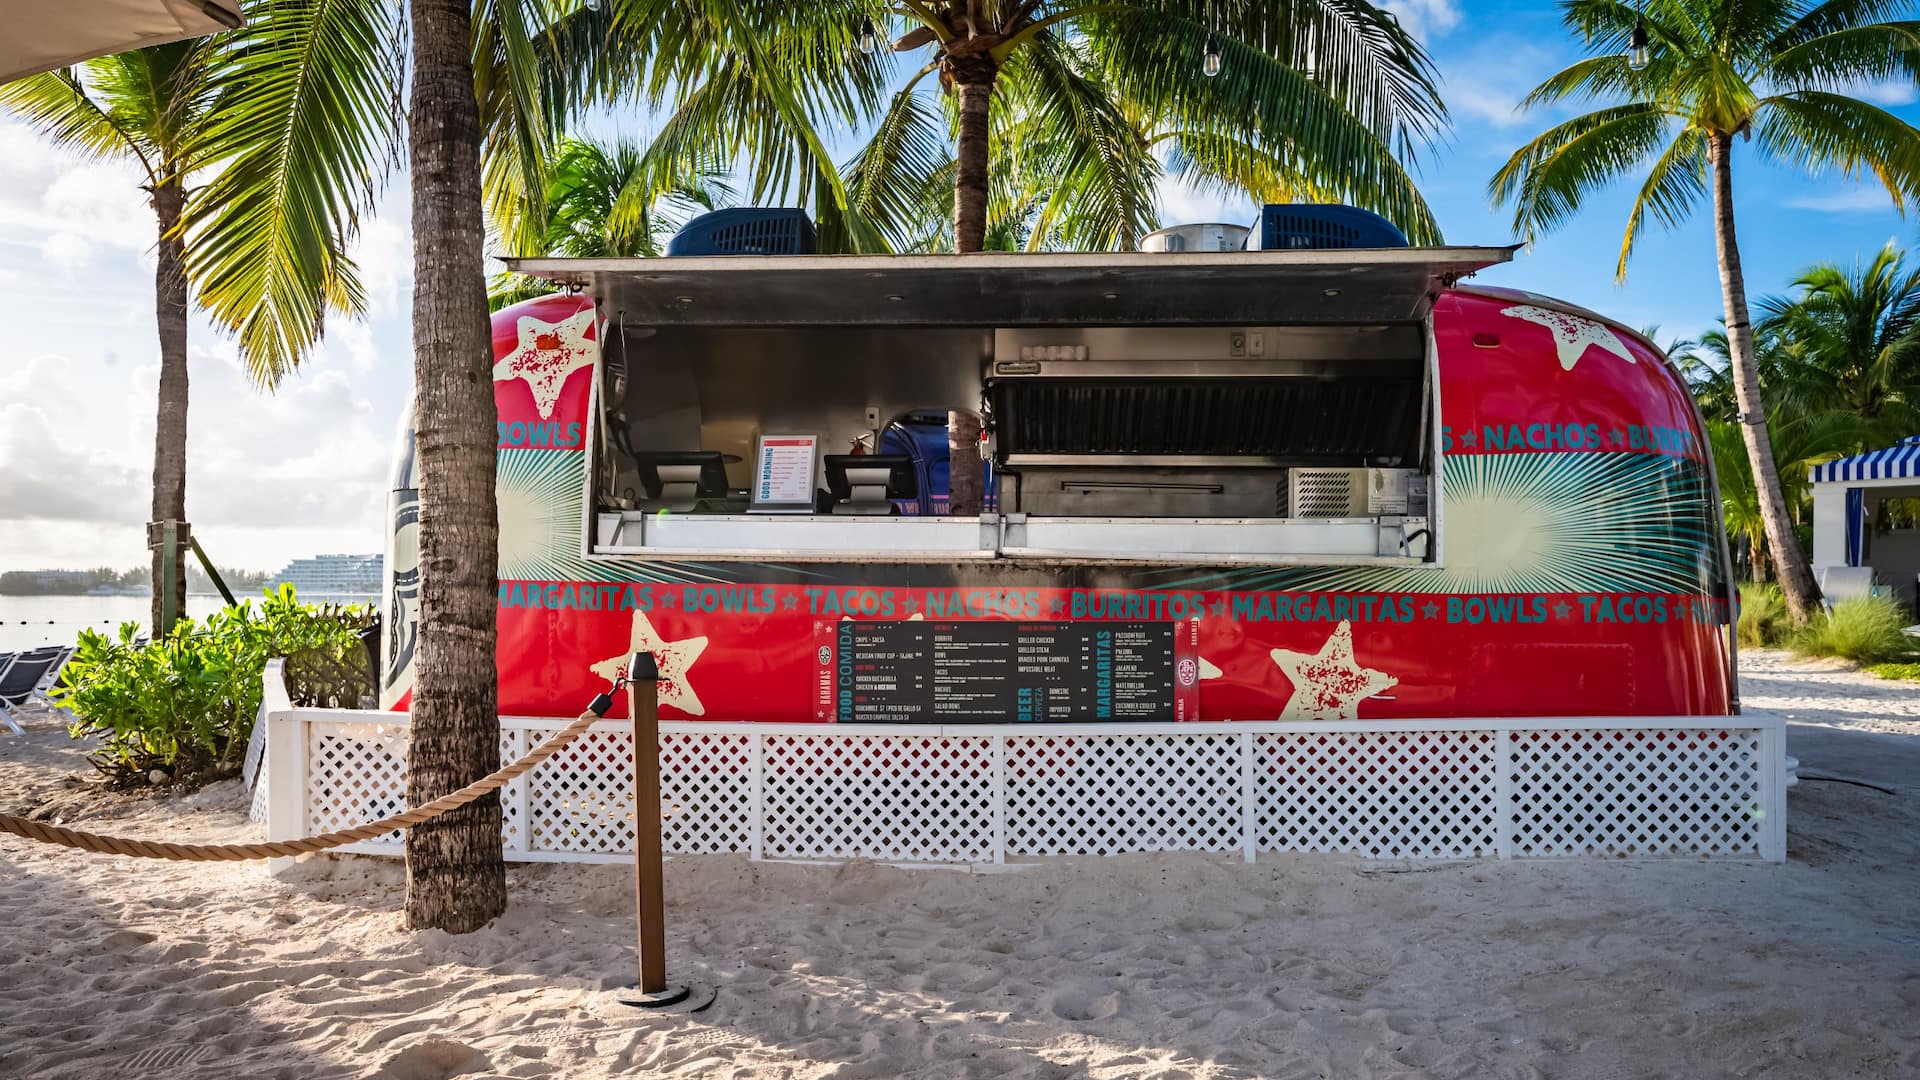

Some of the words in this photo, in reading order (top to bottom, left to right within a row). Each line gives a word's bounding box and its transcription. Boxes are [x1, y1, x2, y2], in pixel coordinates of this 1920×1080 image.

[1484, 423, 1602, 451] NACHOS
[761, 481, 771, 499] GOOD
[683, 587, 776, 614] BOWLS
[804, 589, 895, 616] TACOS
[926, 591, 1041, 617] NACHOS
[1072, 592, 1205, 619] BURRITOS
[1232, 595, 1415, 622] MARGARITAS
[1447, 596, 1548, 623] BOWLS
[1578, 596, 1668, 623] TACOS
[840, 624, 852, 688] COMIDA
[820, 670, 831, 704] BAHAMAS
[1097, 631, 1111, 718] MARGARITAS
[840, 690, 852, 720] FOOD
[1018, 688, 1032, 720] BEER
